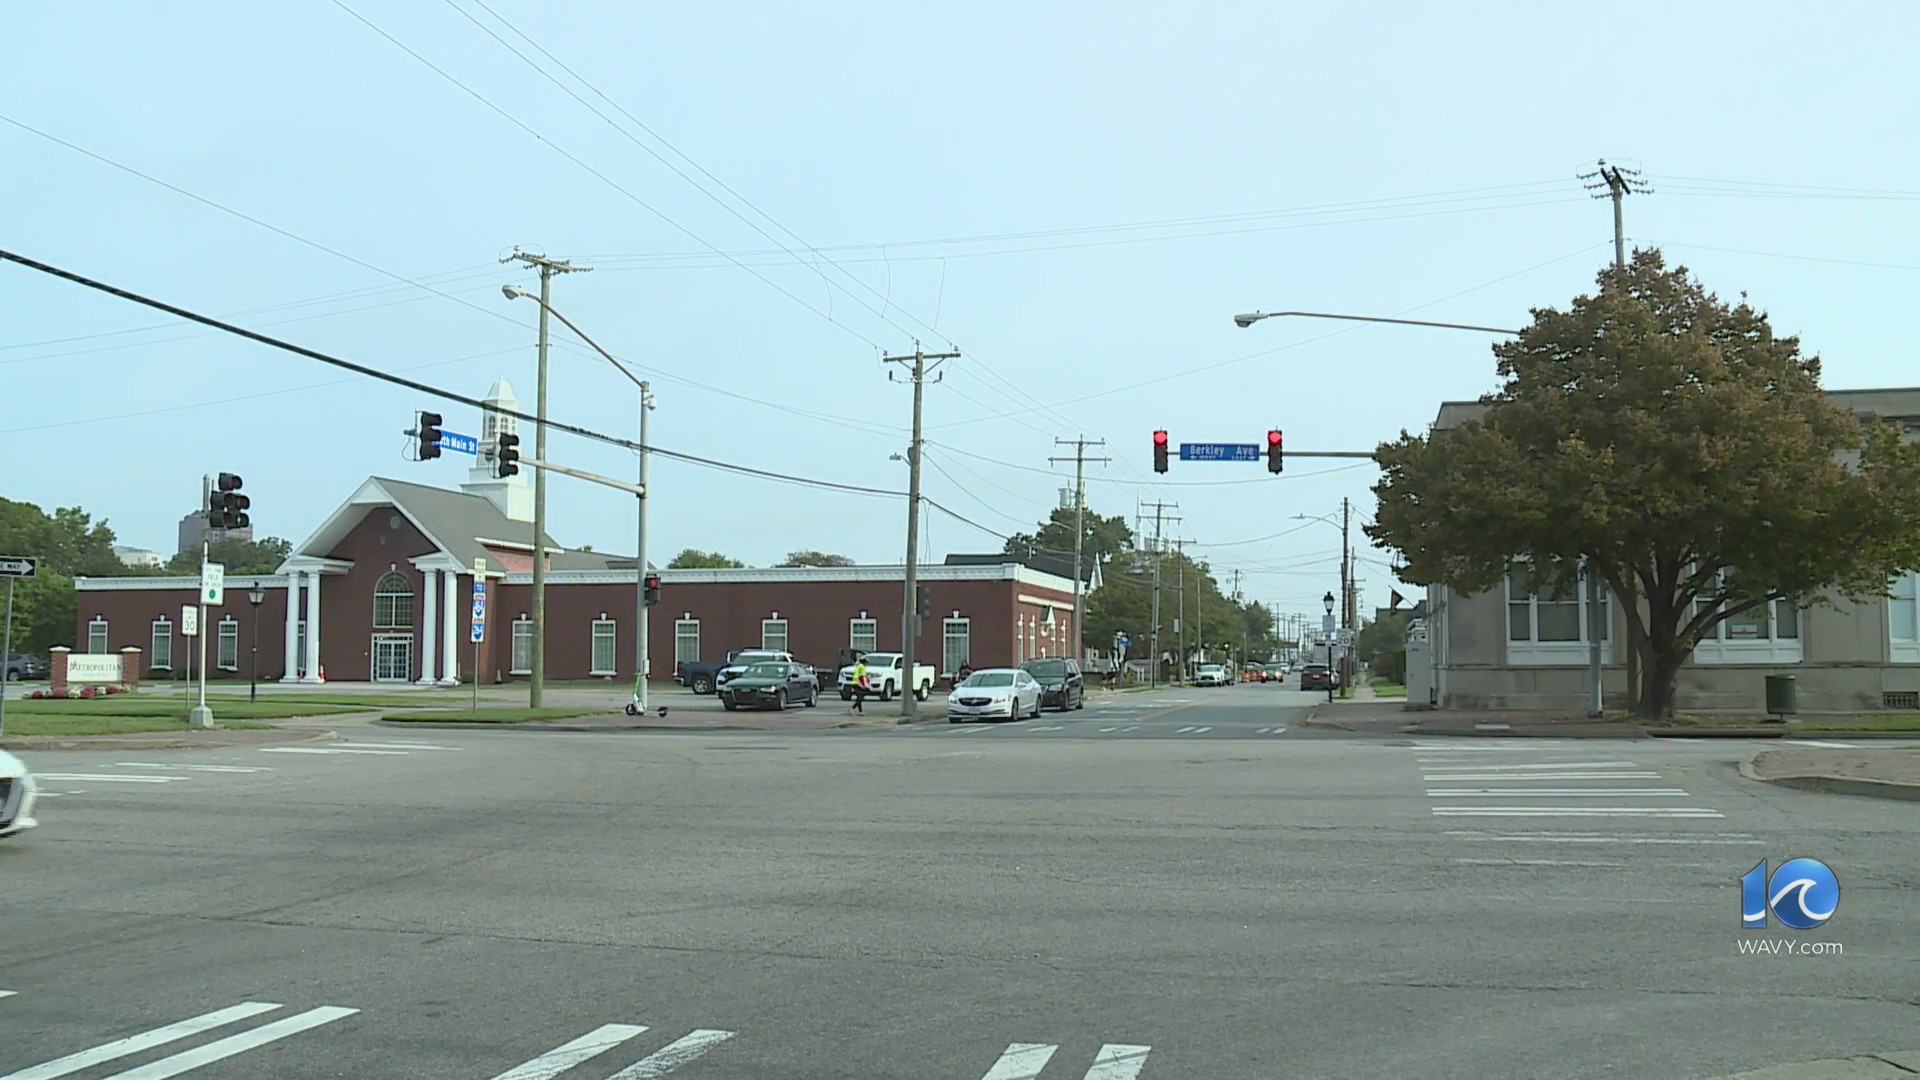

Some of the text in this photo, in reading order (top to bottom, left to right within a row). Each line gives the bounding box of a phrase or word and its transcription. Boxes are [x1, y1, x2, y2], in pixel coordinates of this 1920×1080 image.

[451, 436, 467, 450] Main
[469, 440, 475, 452] St
[1190, 445, 1254, 457] Berkley Ave
[185, 620, 195, 631] 30
[70, 660, 121, 671] METROPOLITAN
